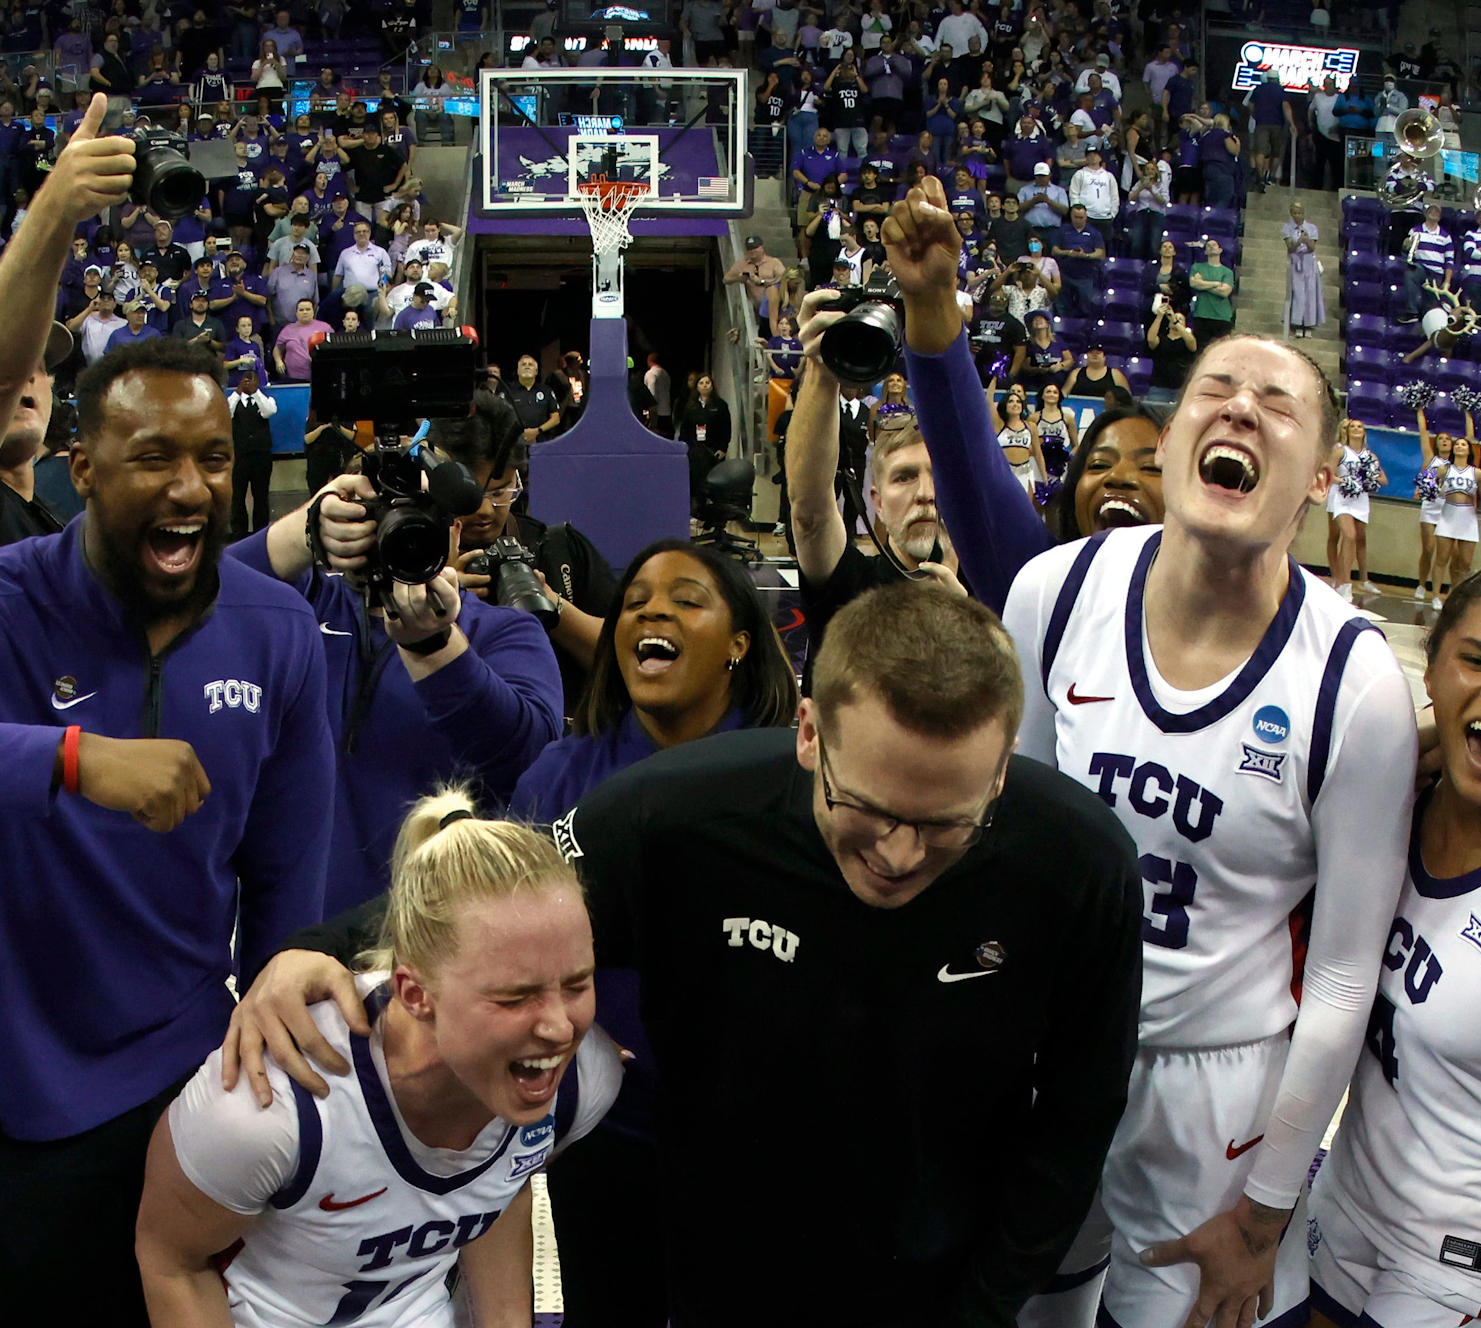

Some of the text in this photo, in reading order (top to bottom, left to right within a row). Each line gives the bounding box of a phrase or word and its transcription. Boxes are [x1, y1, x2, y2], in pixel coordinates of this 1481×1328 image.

[767, 96, 784, 108] TCU
[838, 89, 858, 99] TCU
[770, 105, 781, 117] 10
[843, 98, 856, 109] 10
[1006, 434, 1029, 446] TCU
[1447, 476, 1478, 493] TCU
[204, 678, 263, 714] TCU
[1255, 718, 1288, 738] NCAA
[1088, 751, 1225, 844] TCU
[722, 916, 800, 963] TCU
[1382, 916, 1444, 1006] CU
[356, 1208, 503, 1274] TCU
